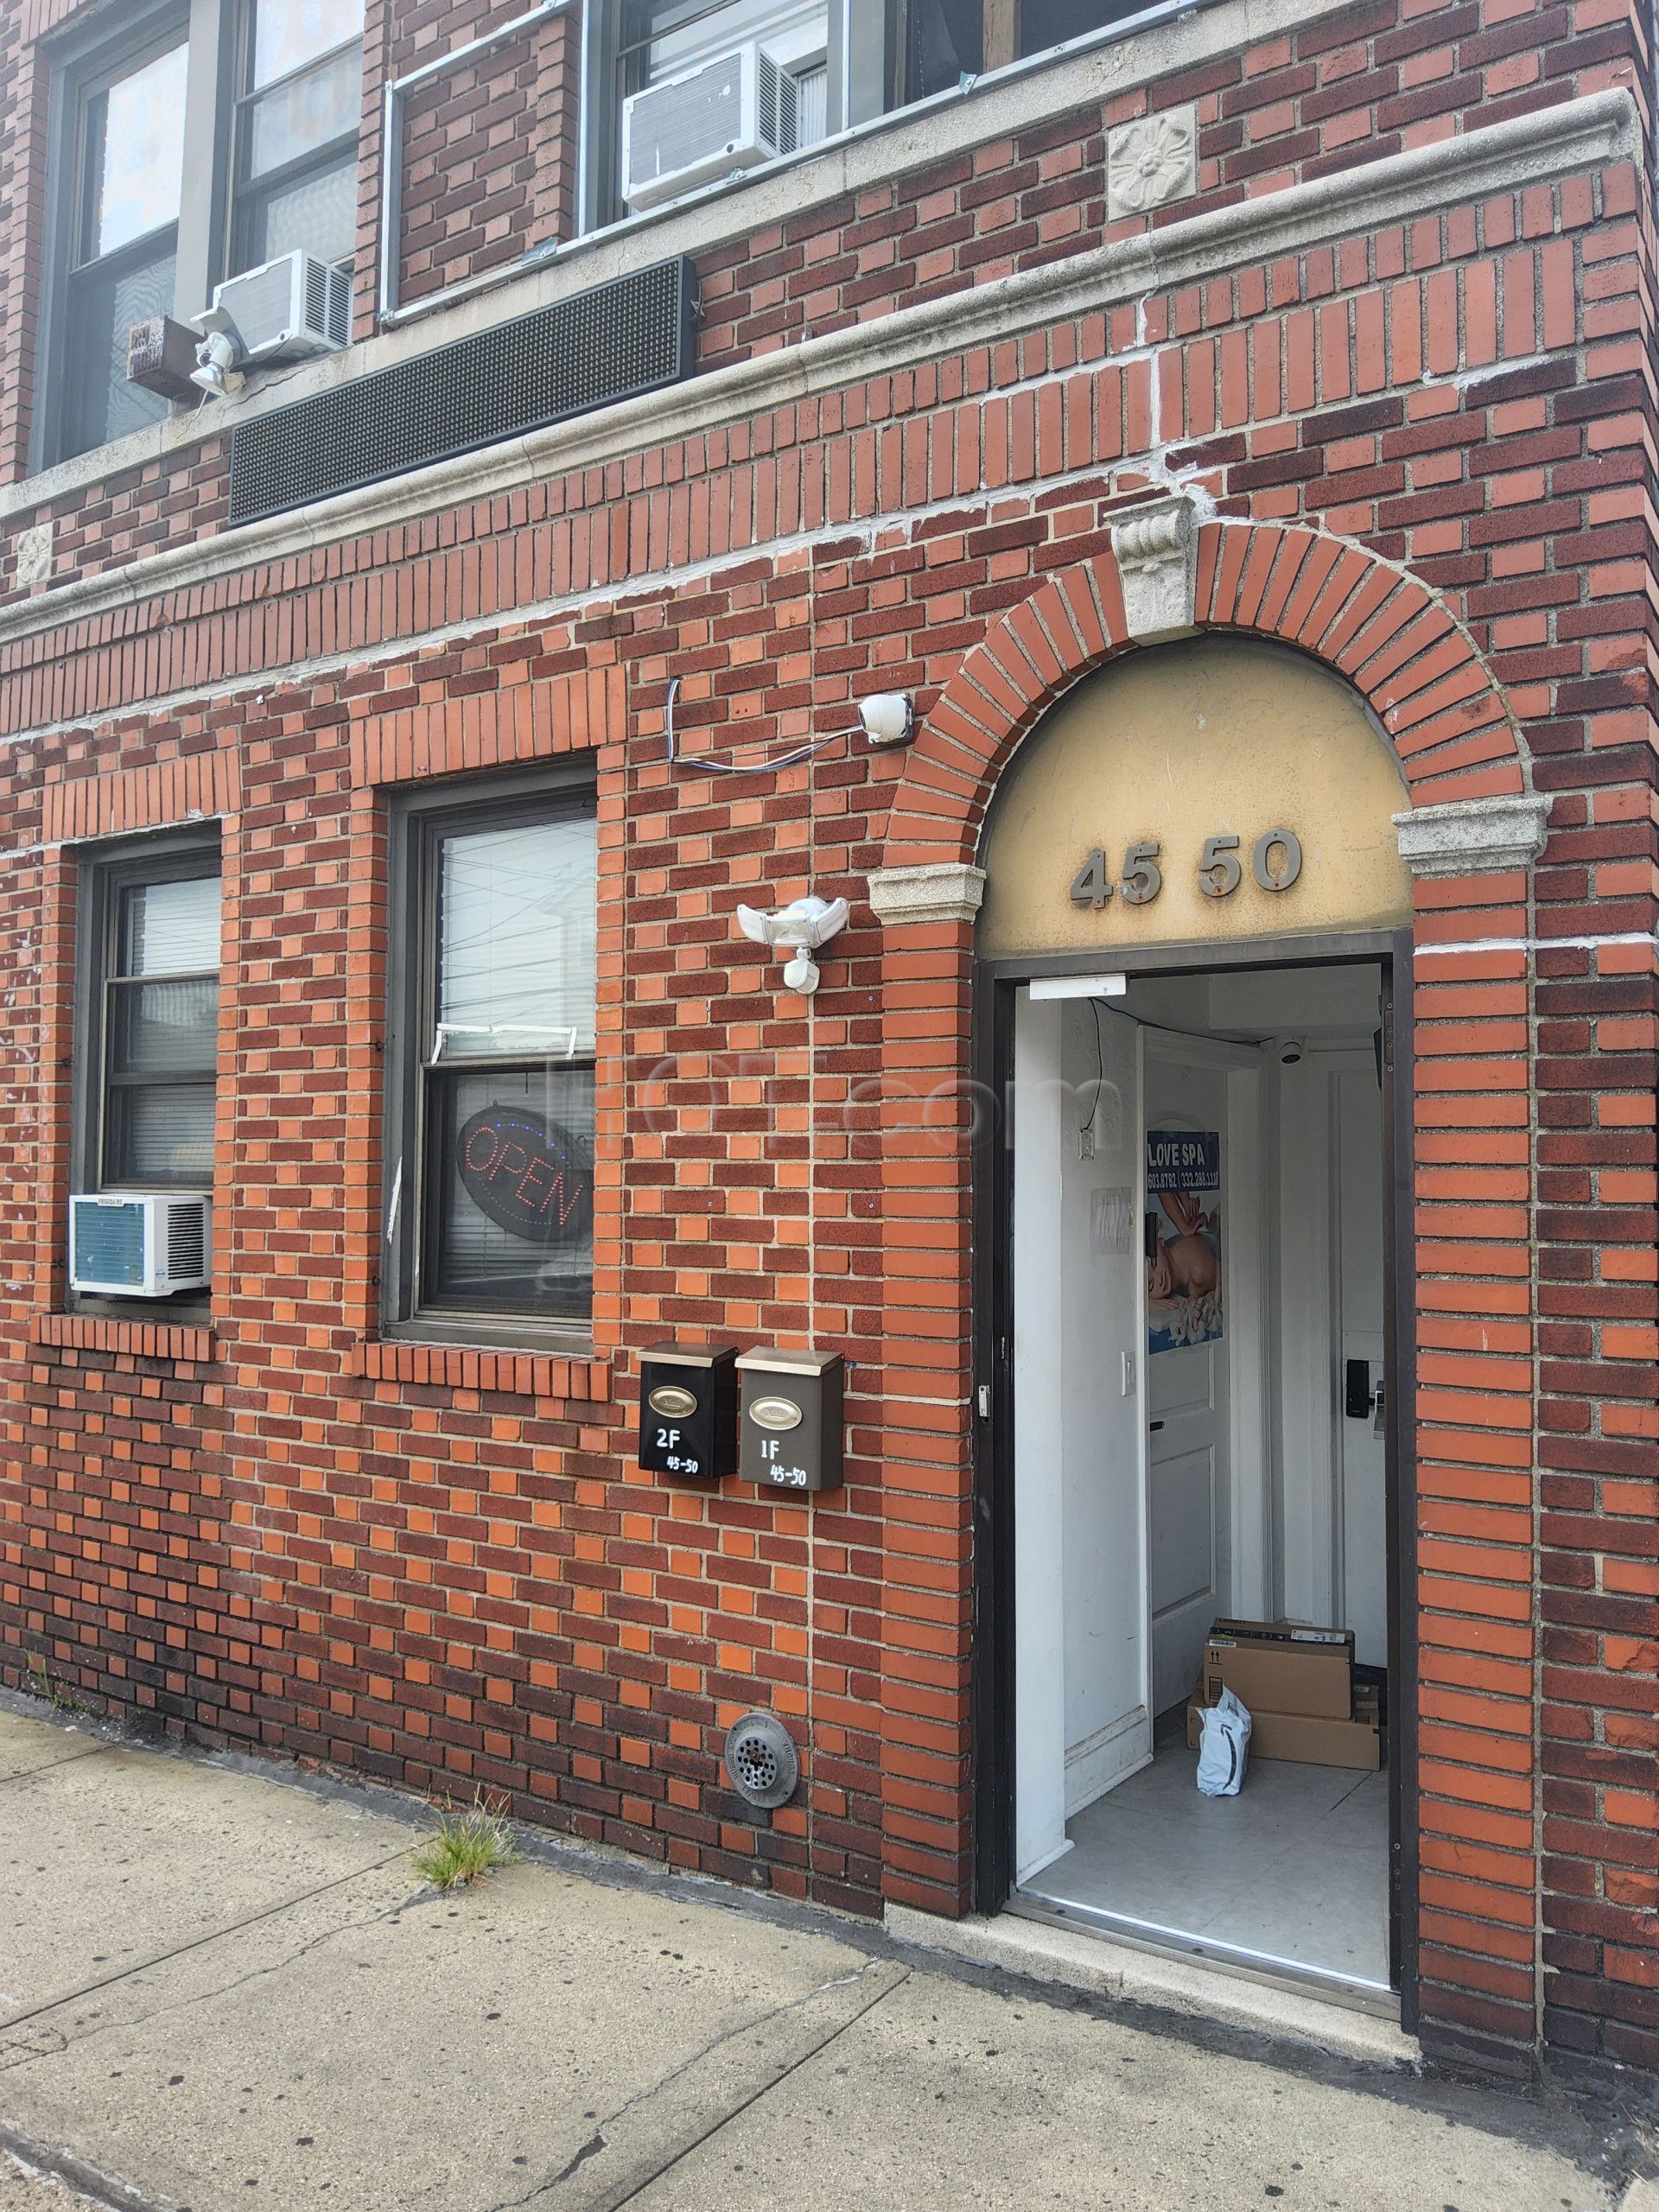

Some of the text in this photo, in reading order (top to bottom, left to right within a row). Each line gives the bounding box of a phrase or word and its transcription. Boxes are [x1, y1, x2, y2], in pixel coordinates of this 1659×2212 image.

[1071, 829, 1303, 909] 45 50
[1147, 1142, 1205, 1166] LOVE SPA
[466, 1127, 584, 1225] OPEN
[657, 1428, 681, 1449] 2F
[760, 1440, 779, 1460] 1F
[666, 1456, 698, 1474] 45-50
[770, 1464, 807, 1486] 45-50
